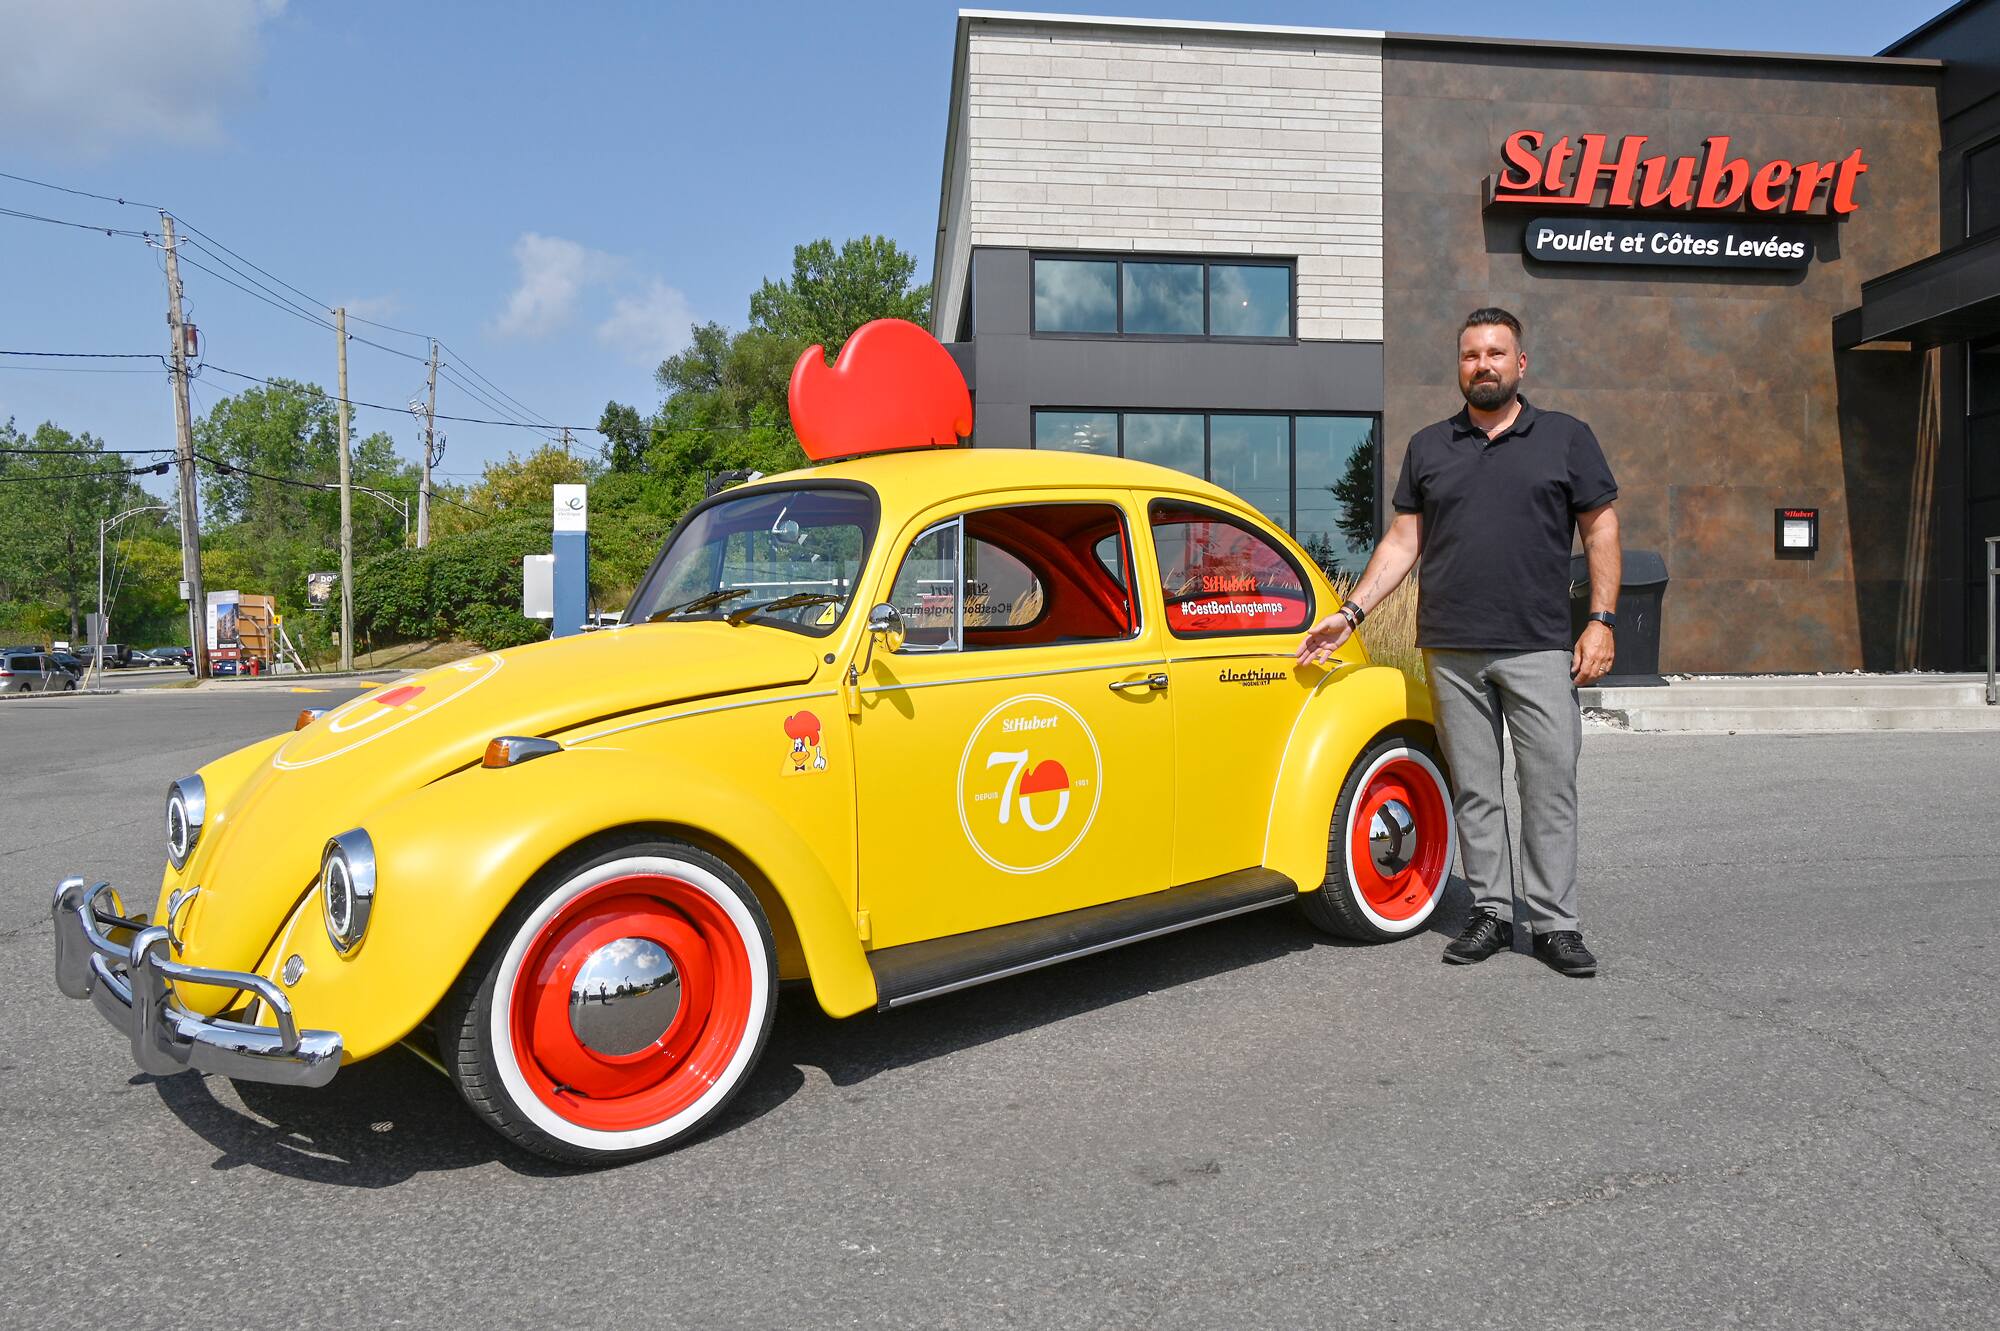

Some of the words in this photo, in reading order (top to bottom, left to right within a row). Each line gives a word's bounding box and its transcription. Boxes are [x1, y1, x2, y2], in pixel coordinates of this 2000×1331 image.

[1536, 228, 1615, 252] Poulet
[1619, 232, 1646, 253] et
[1650, 232, 1720, 256] Côtes
[1725, 235, 1805, 259] Levées
[1181, 600, 1283, 617] #CestBonLongtemps
[986, 748, 1070, 832] 70
